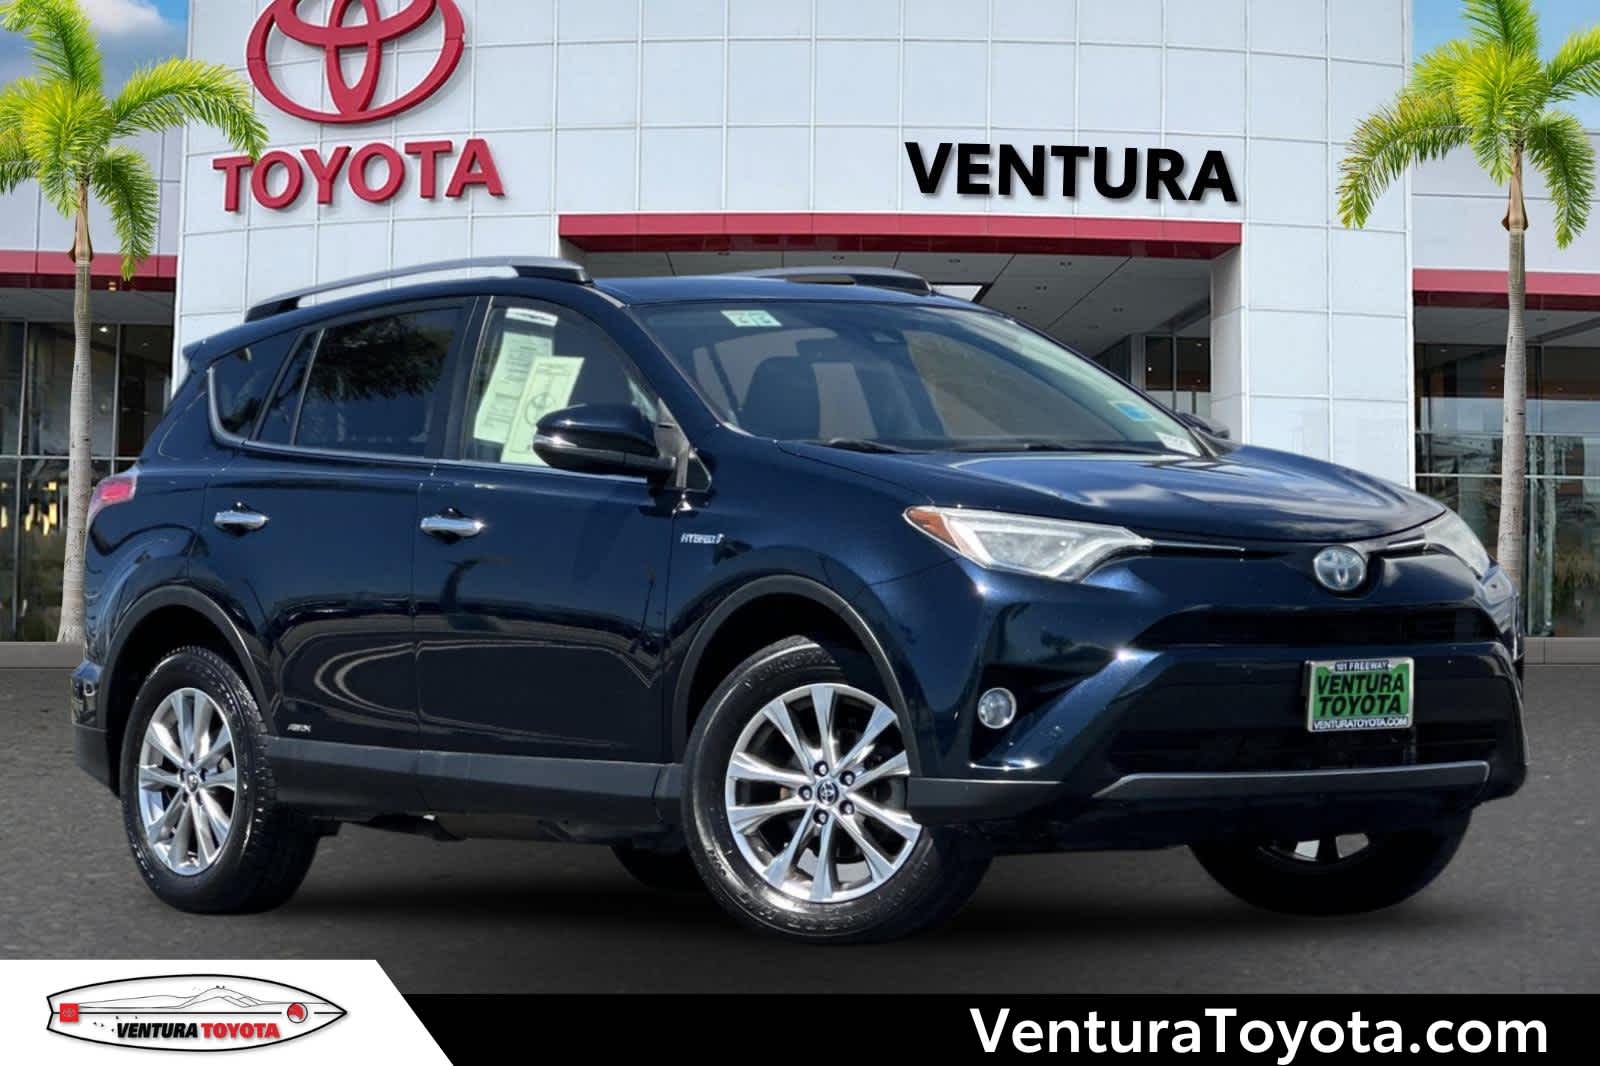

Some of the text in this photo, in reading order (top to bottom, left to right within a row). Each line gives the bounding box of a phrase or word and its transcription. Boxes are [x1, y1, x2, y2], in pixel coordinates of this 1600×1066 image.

[212, 138, 505, 212] TOYOTA
[904, 141, 1241, 202] VENTURA
[1349, 661, 1386, 671] FREEWAY
[1317, 673, 1404, 695] VENTURA
[1318, 694, 1402, 717] TOYOTA
[1314, 717, 1408, 730] VENTURATOYOTA.COM
